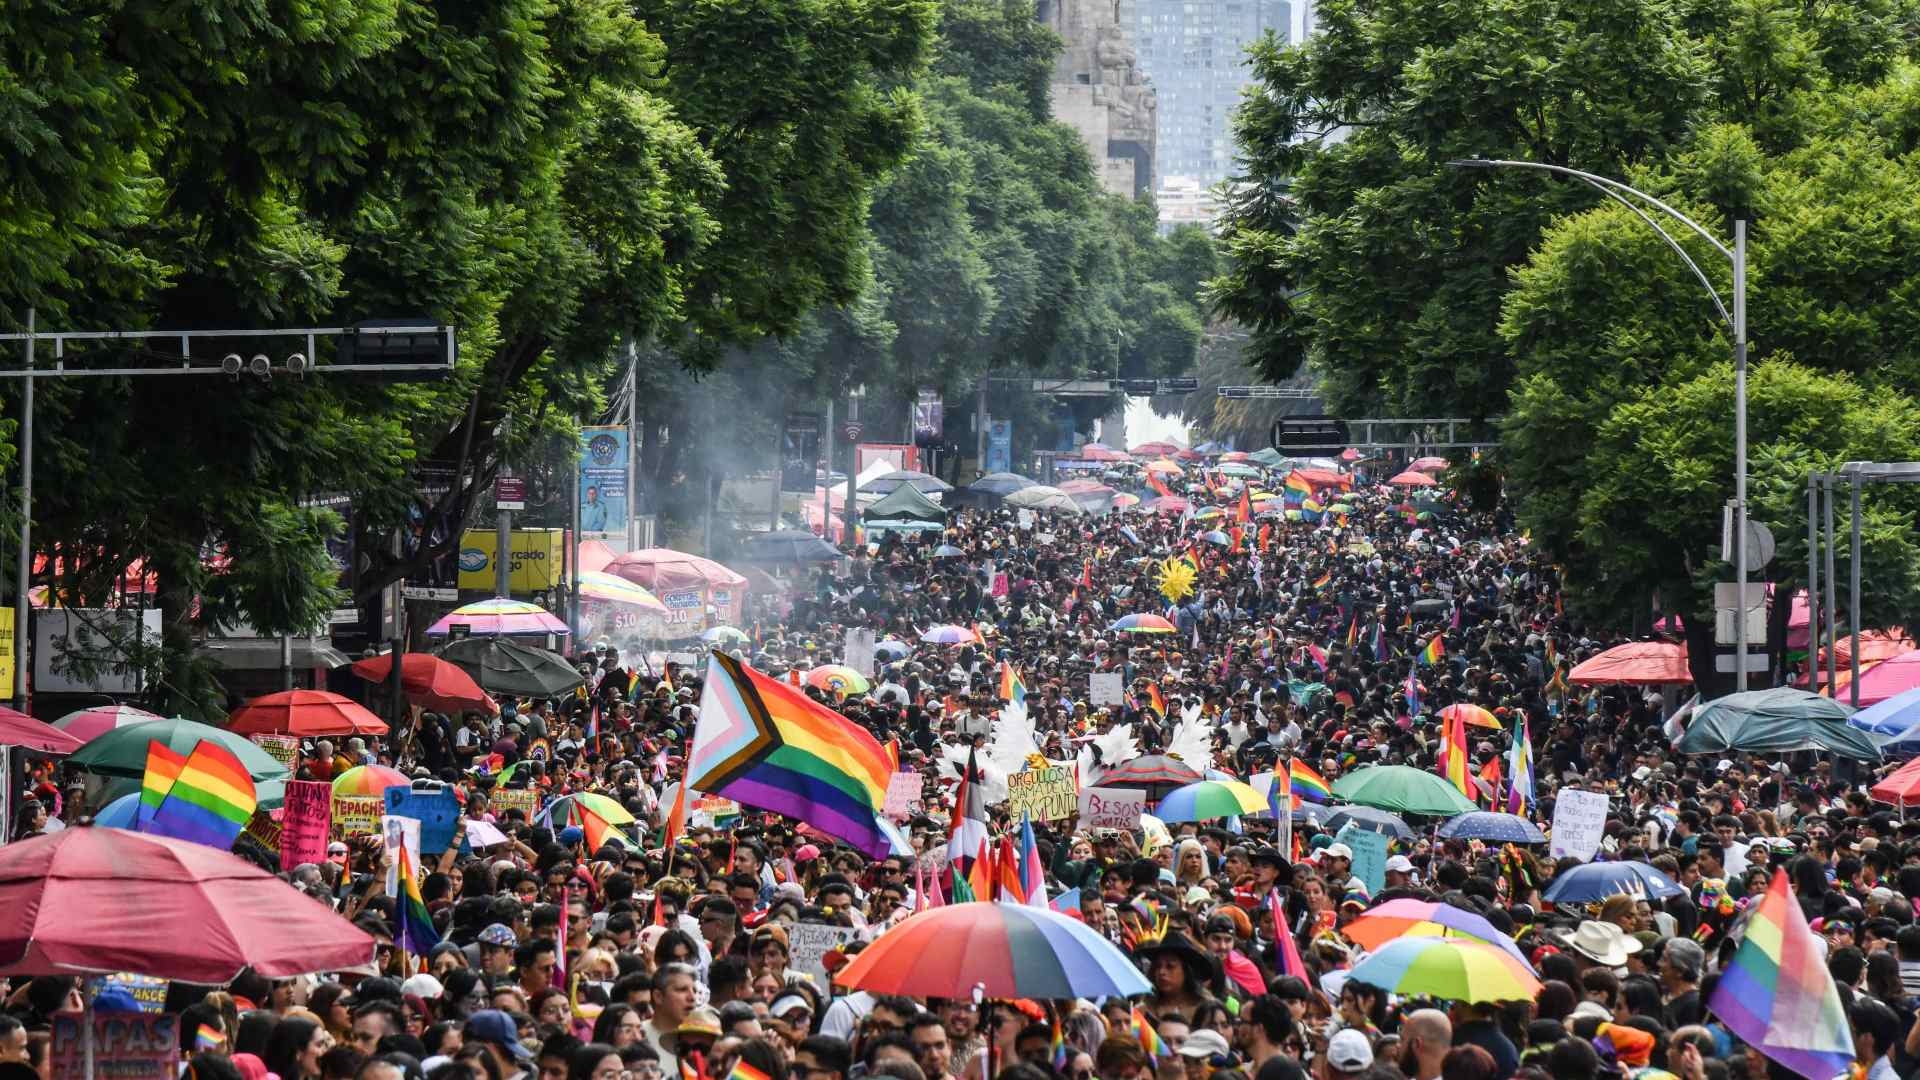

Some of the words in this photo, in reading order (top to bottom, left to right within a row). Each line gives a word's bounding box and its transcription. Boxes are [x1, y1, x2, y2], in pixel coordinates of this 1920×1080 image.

[493, 550, 545, 560] rcado
[493, 562, 522, 573] pgo
[1008, 765, 1073, 788] ORGULLOSA
[333, 798, 385, 817] TEPACHE
[1088, 793, 1141, 818] BESOS
[55, 1017, 175, 1053] PAPAS
